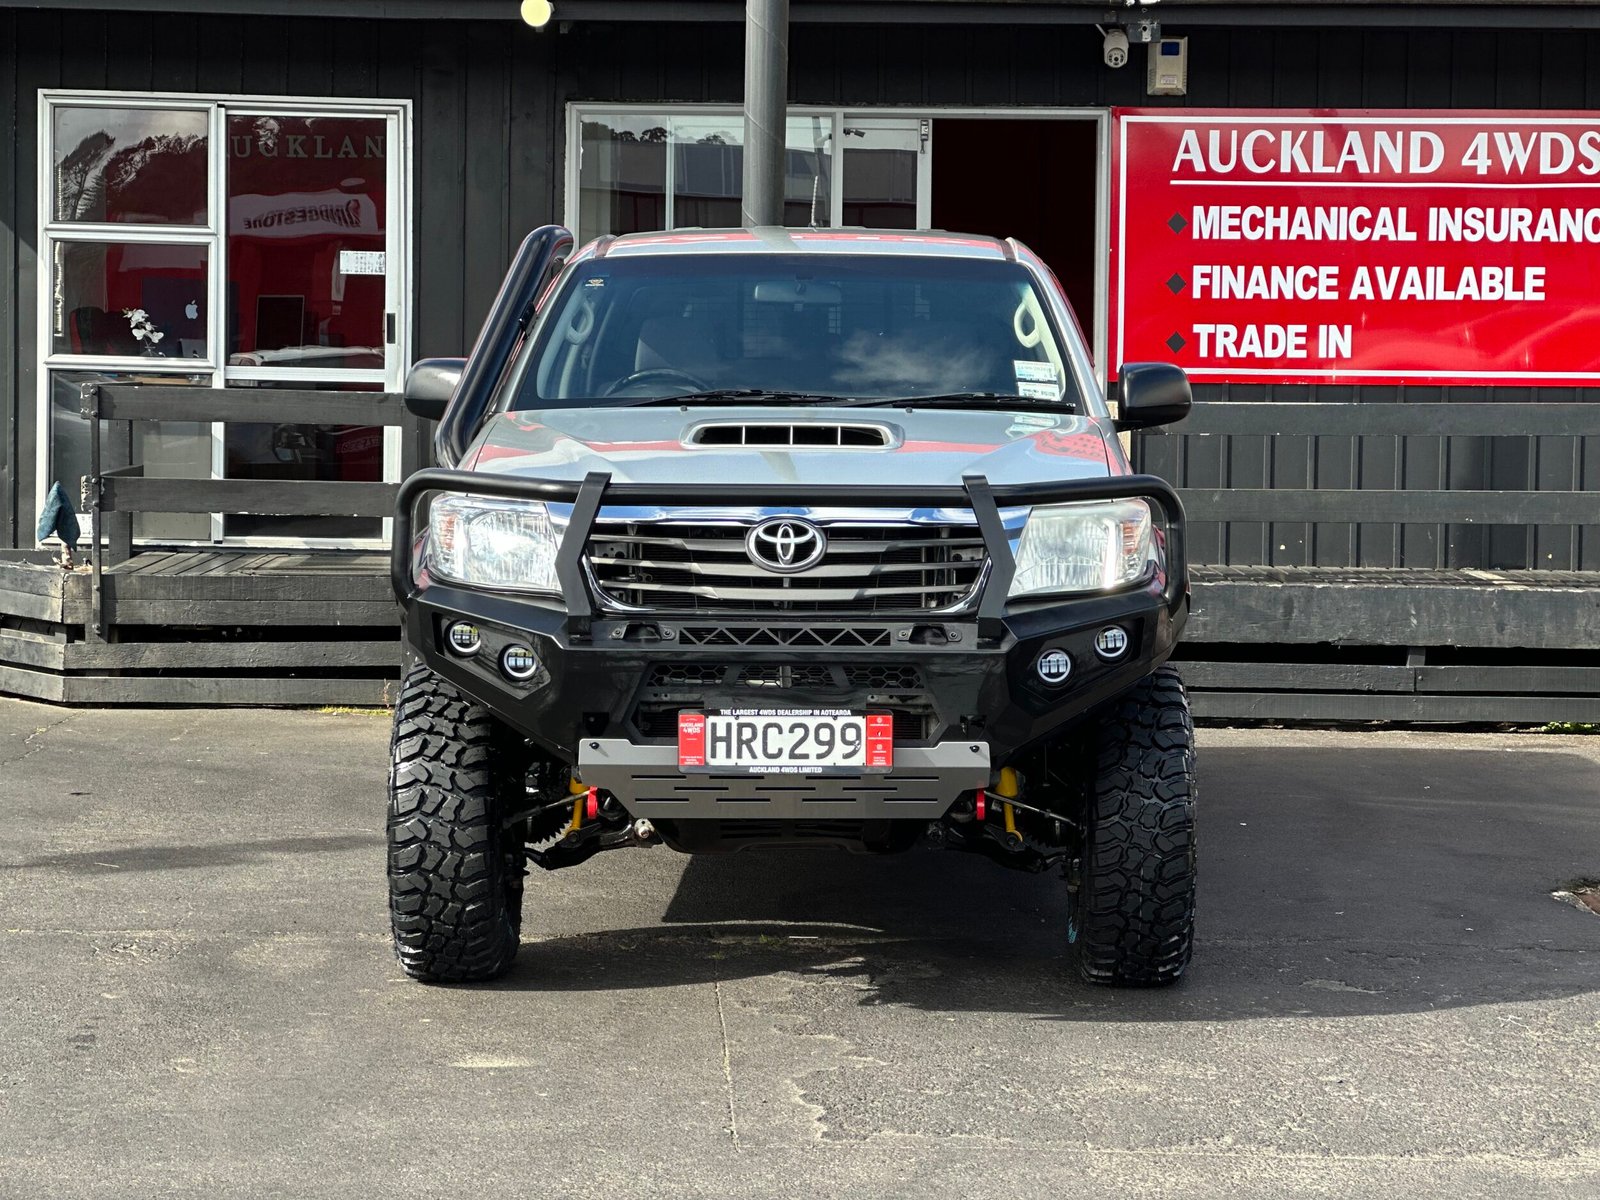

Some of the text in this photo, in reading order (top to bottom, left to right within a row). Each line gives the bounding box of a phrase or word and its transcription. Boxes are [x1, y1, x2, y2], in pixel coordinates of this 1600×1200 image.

[1172, 129, 1600, 176] AUCKLAND 4WDS
[1192, 205, 1600, 243] MECHANICAL INSURANC
[1192, 265, 1546, 302] FINANCE AVAILABLE
[1193, 324, 1352, 359] TRADE IN
[710, 722, 862, 760] HRC299
